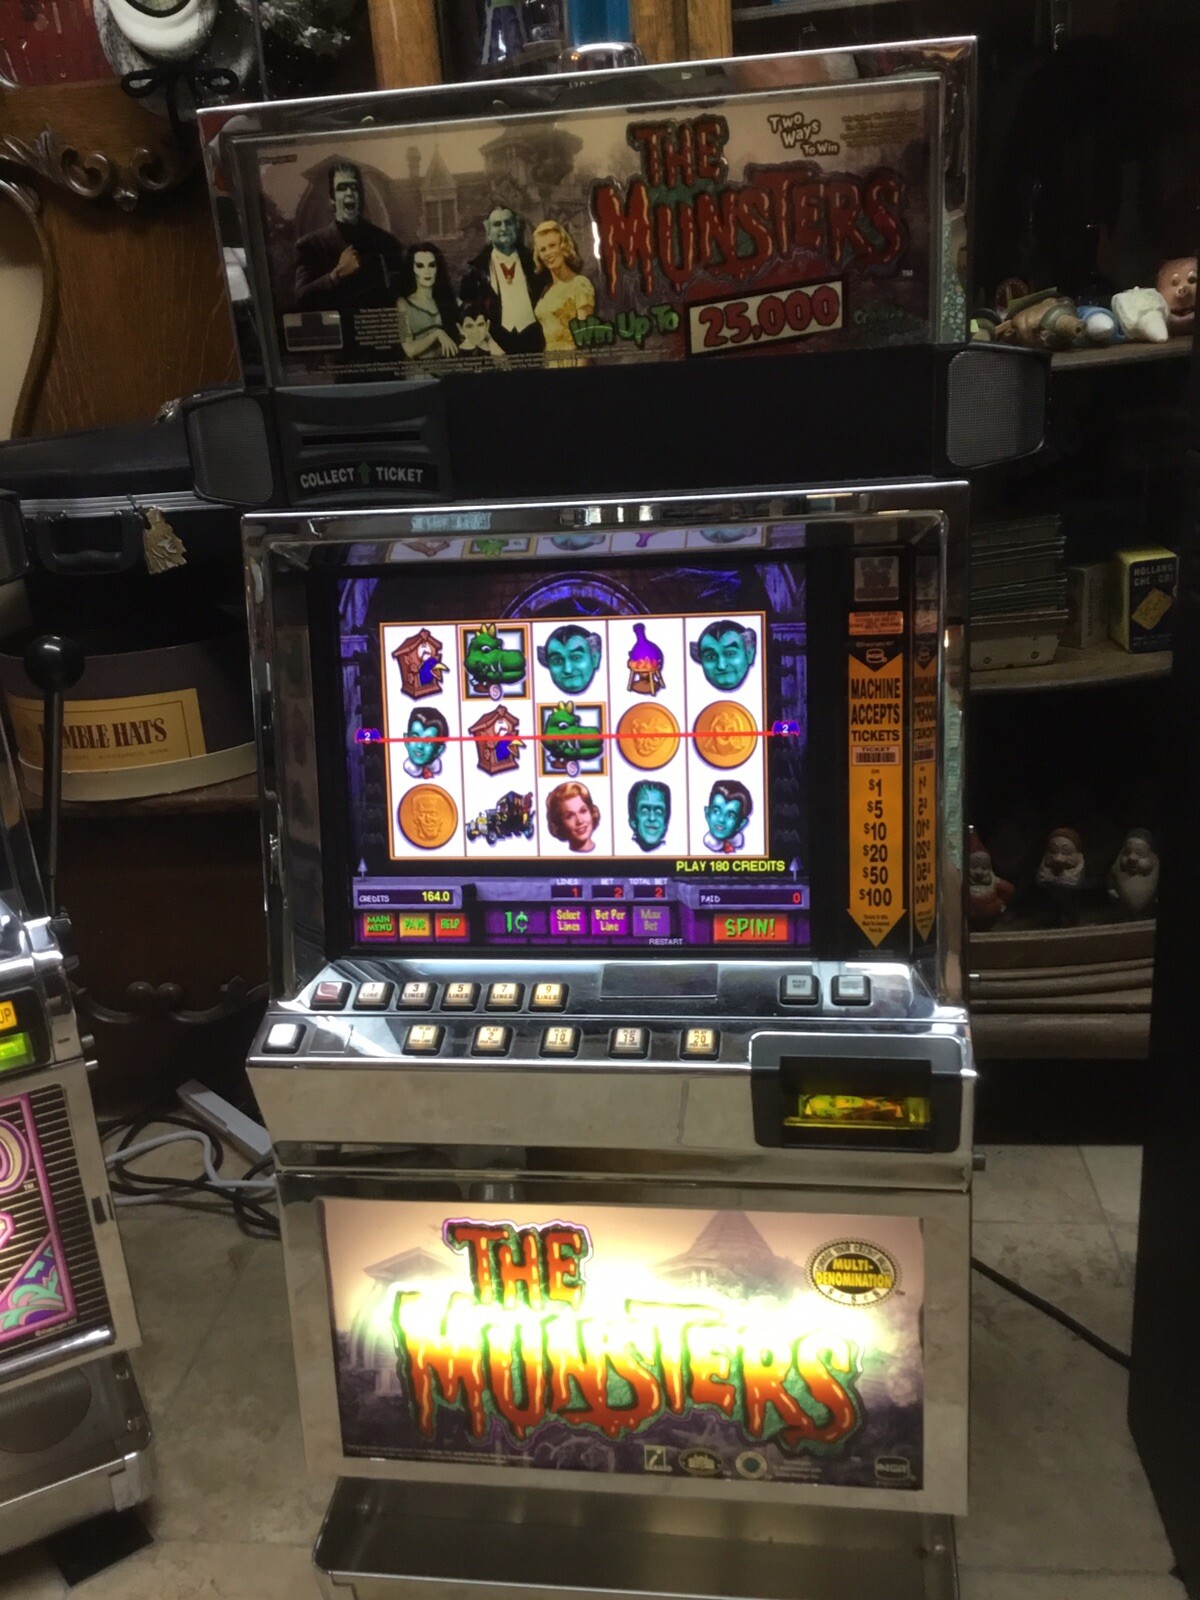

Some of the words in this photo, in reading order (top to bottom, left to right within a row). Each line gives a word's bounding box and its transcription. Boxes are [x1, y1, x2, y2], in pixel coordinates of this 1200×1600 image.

[767, 114, 803, 133] Two
[781, 120, 820, 147] Ways
[630, 118, 727, 188] THE
[801, 143, 816, 155] To
[816, 141, 839, 154] Win
[595, 167, 900, 296] MUNSTERS
[570, 315, 614, 347] Win
[616, 310, 650, 345] Up
[650, 304, 680, 331] To
[698, 284, 841, 348] 25,000
[301, 467, 354, 488] COLLECT
[375, 466, 423, 483] TICKET
[851, 678, 900, 700] MACHINE
[851, 703, 900, 726] ACCEPTS
[112, 717, 167, 747] HATS
[851, 729, 900, 742] TICKETS
[868, 778, 882, 797] $1
[867, 800, 883, 819] $5
[864, 822, 887, 841] $10
[863, 844, 888, 863] $20
[676, 861, 706, 872] PLAY
[710, 861, 729, 872] 180
[732, 860, 785, 872] CREDITS
[863, 866, 889, 885] $50
[422, 891, 450, 902] 164.0
[614, 887, 623, 898] 2
[655, 887, 663, 898] 2
[792, 893, 801, 903] 0
[859, 887, 892, 907] $100
[701, 895, 721, 903] PAID
[367, 915, 390, 923] MAIN
[556, 909, 581, 920] Select
[595, 909, 609, 920] Bet
[610, 909, 626, 920] Per
[641, 909, 662, 920] Max
[367, 923, 392, 932] MENU
[441, 918, 460, 929] HELP
[504, 911, 529, 934] 1¢
[558, 921, 580, 931] Lines
[600, 921, 619, 931] Line
[643, 921, 658, 931] Bet
[724, 917, 775, 937] SPIN!
[412, 983, 419, 992] 3
[457, 984, 464, 992] 5
[501, 984, 508, 992] 7
[545, 985, 552, 993] 9
[487, 1032, 494, 1040] 2
[554, 1033, 566, 1041] 10
[623, 1034, 635, 1042] 15
[694, 1034, 706, 1043] 20
[452, 1225, 582, 1309] THE
[832, 1258, 874, 1271] MULTI-
[815, 1270, 893, 1289] DENOMINATION
[395, 1293, 858, 1446] MUNSTERS
